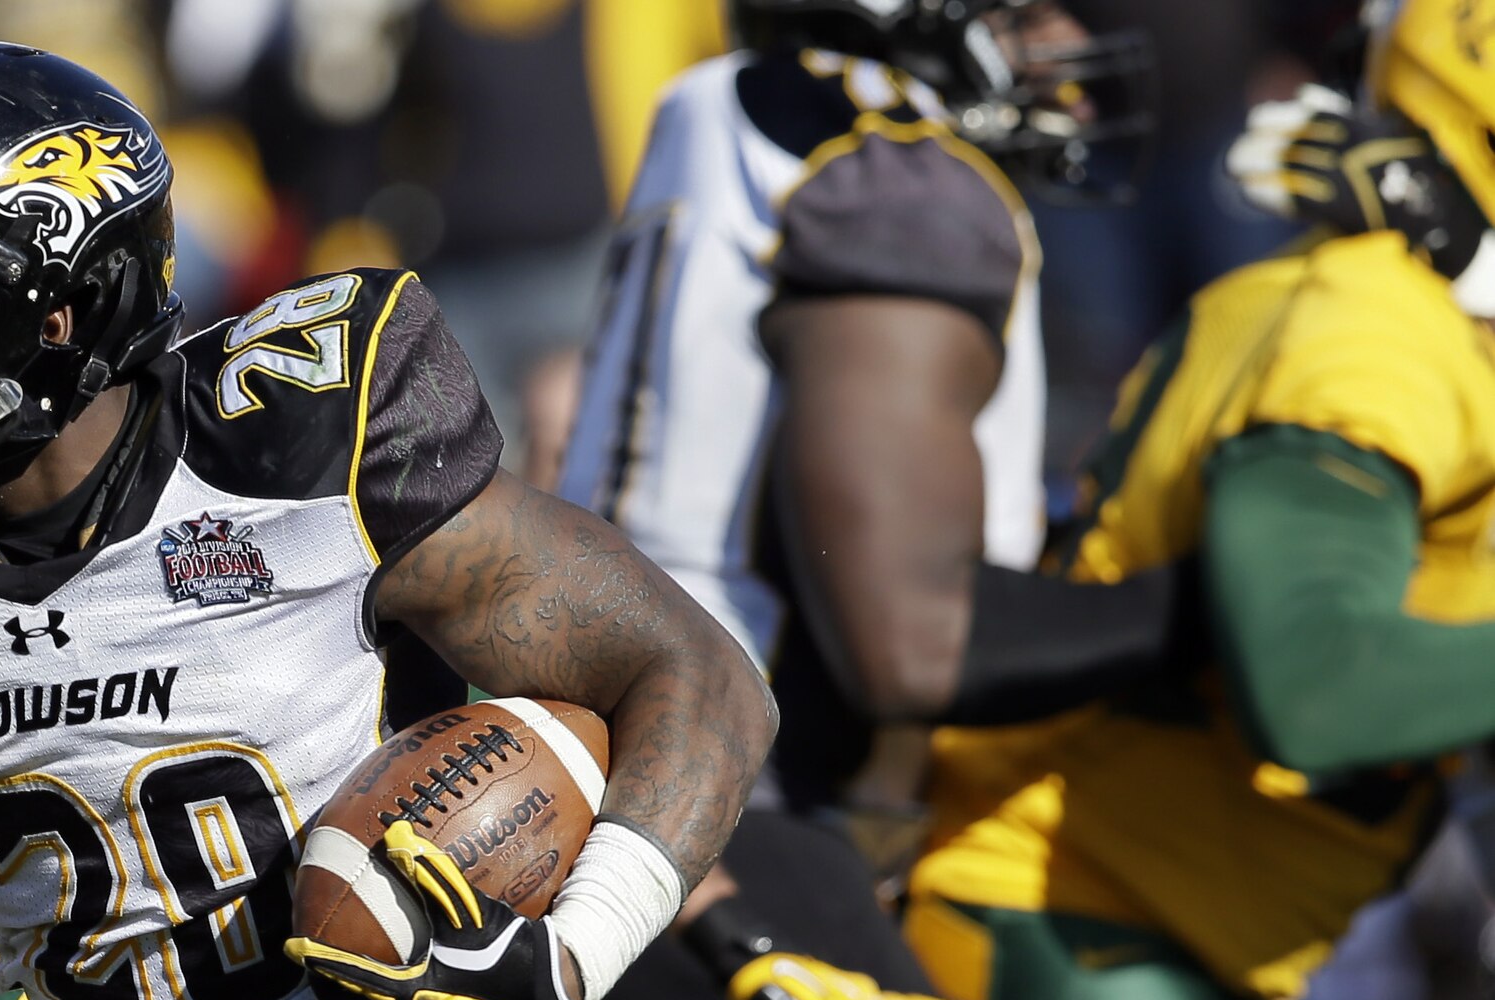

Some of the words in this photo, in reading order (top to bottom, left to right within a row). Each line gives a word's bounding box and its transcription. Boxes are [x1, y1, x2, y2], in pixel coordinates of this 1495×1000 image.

[216, 274, 363, 420] 28
[198, 541, 243, 554] DIVISION
[164, 549, 271, 587] FOOTBALL
[187, 577, 254, 593] CHAMPIONSHIP
